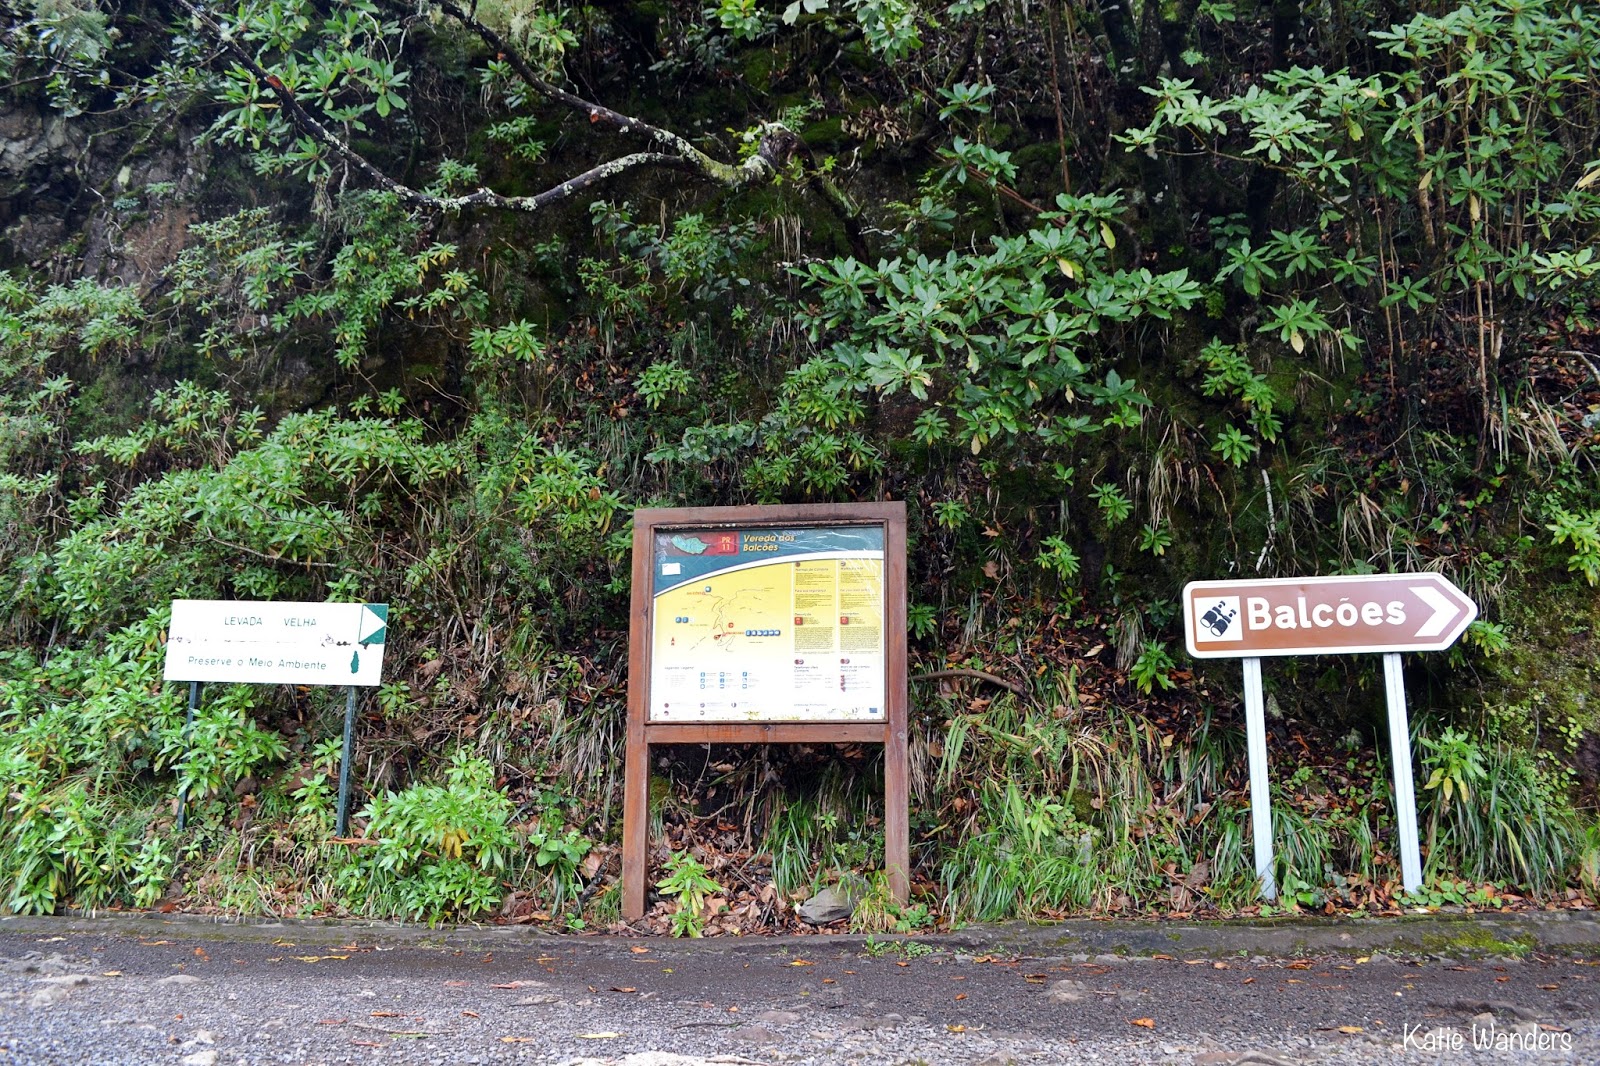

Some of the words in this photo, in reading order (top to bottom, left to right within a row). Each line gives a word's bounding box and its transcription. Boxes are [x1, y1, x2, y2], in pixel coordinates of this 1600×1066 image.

[721, 536, 732, 544] PR
[743, 534, 776, 543] Vereda
[778, 533, 795, 542] dos
[743, 542, 779, 552] Balcões
[1247, 597, 1407, 630] Balcões
[224, 616, 263, 626] LEVADA
[283, 618, 317, 627] VELHA
[188, 656, 232, 666] Preserve
[237, 658, 244, 666] o
[249, 658, 273, 668] Meio
[278, 659, 327, 670] Ambiente
